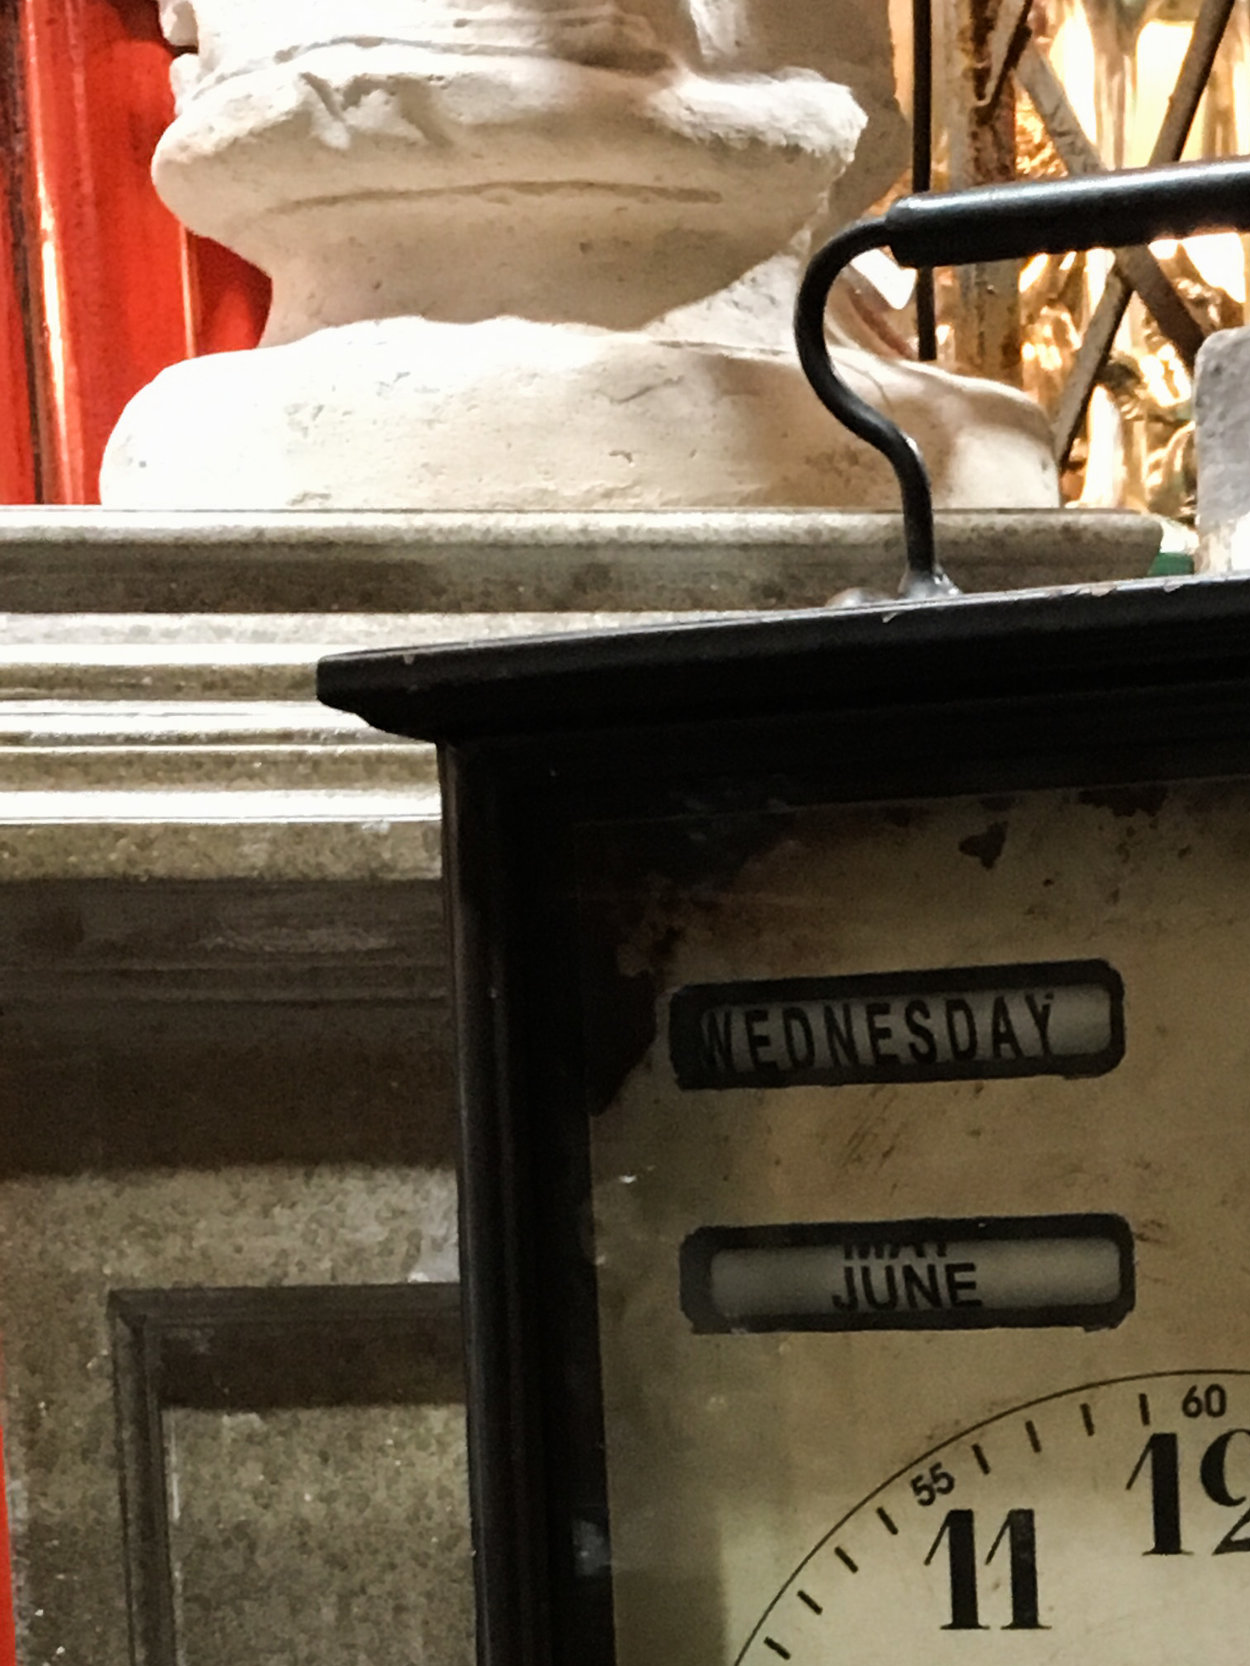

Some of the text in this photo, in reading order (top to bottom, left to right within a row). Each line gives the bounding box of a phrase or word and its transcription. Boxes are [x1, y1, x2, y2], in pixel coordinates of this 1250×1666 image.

[702, 992, 1054, 1073] WEDNESDAY
[831, 1262, 983, 1313] JUNE
[1181, 1383, 1228, 1418] 60
[909, 1461, 956, 1507] 55
[923, 1508, 1053, 1631] 11
